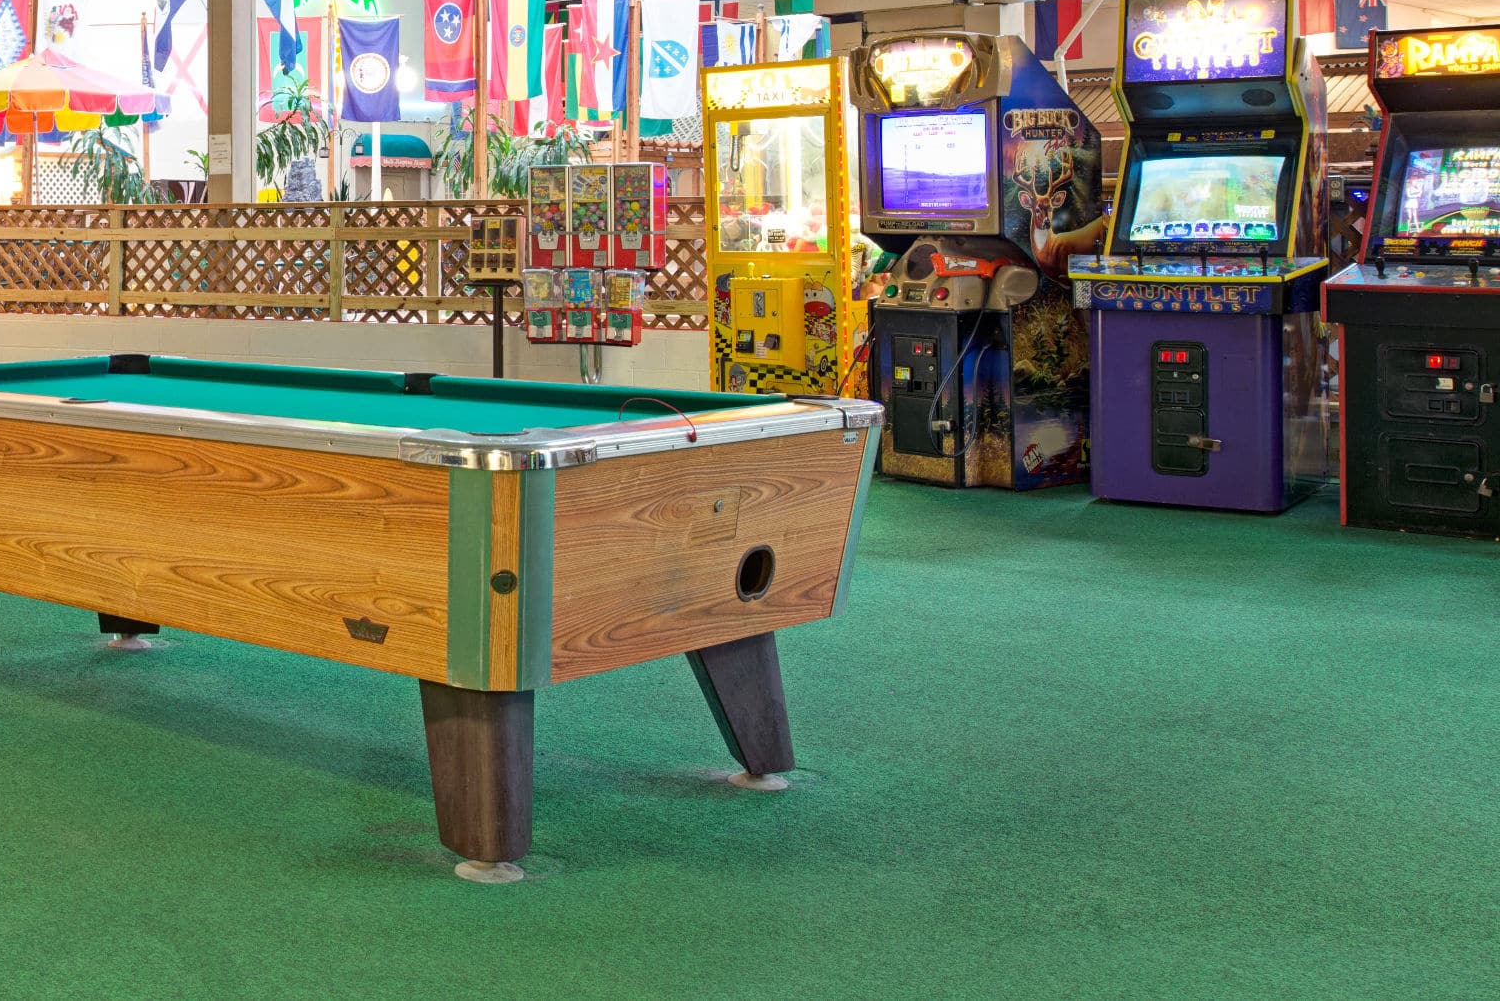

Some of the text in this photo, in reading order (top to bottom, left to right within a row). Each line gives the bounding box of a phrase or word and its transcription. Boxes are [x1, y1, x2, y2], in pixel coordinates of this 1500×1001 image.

[1402, 36, 1500, 75] RAMPA
[757, 92, 785, 103] TAXI
[1011, 109, 1074, 133] BIG BUCK
[1025, 128, 1063, 138] HUNTER
[1450, 239, 1487, 248] PUNCH
[1092, 282, 1262, 304] GAUNTLET
[1116, 301, 1243, 312] LEGENDS
